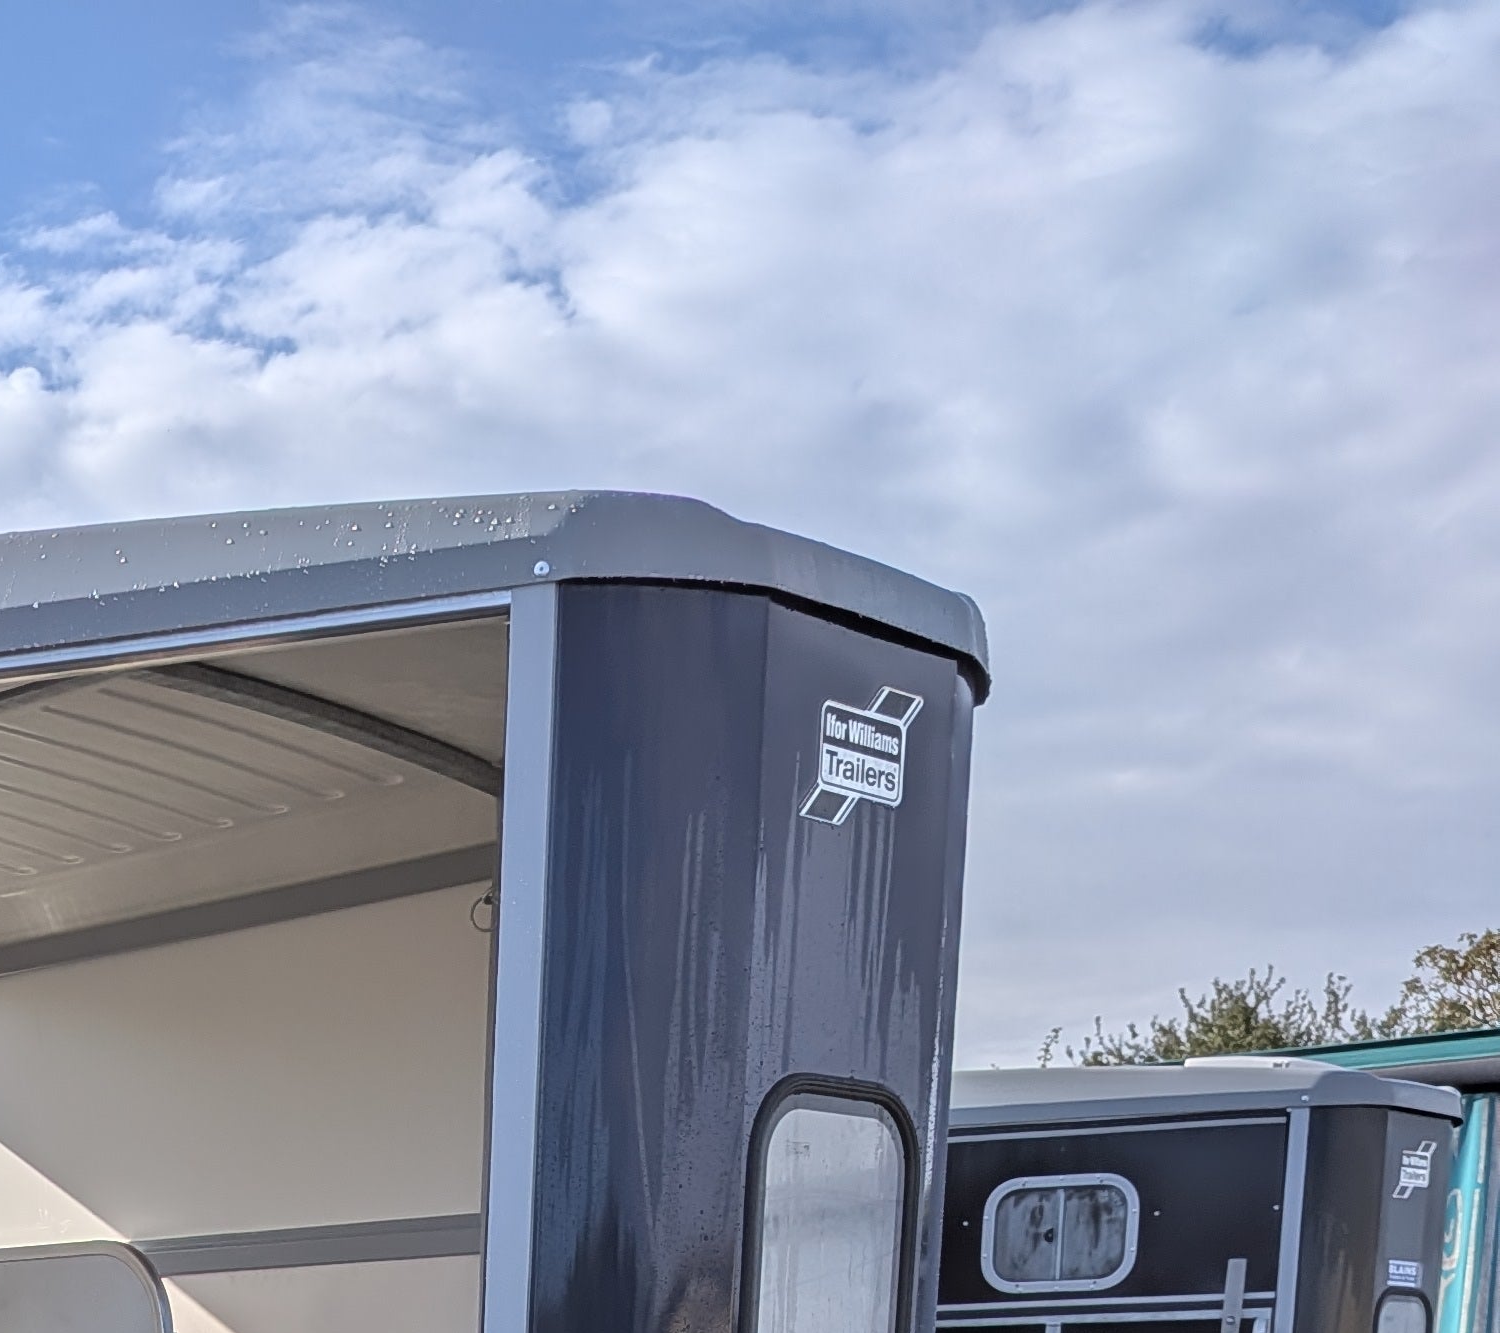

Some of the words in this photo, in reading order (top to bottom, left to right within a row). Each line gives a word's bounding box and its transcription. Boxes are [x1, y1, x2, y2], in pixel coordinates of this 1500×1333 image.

[826, 713, 847, 740] Ifor
[849, 719, 899, 756] Williams
[826, 749, 896, 792] Trailers
